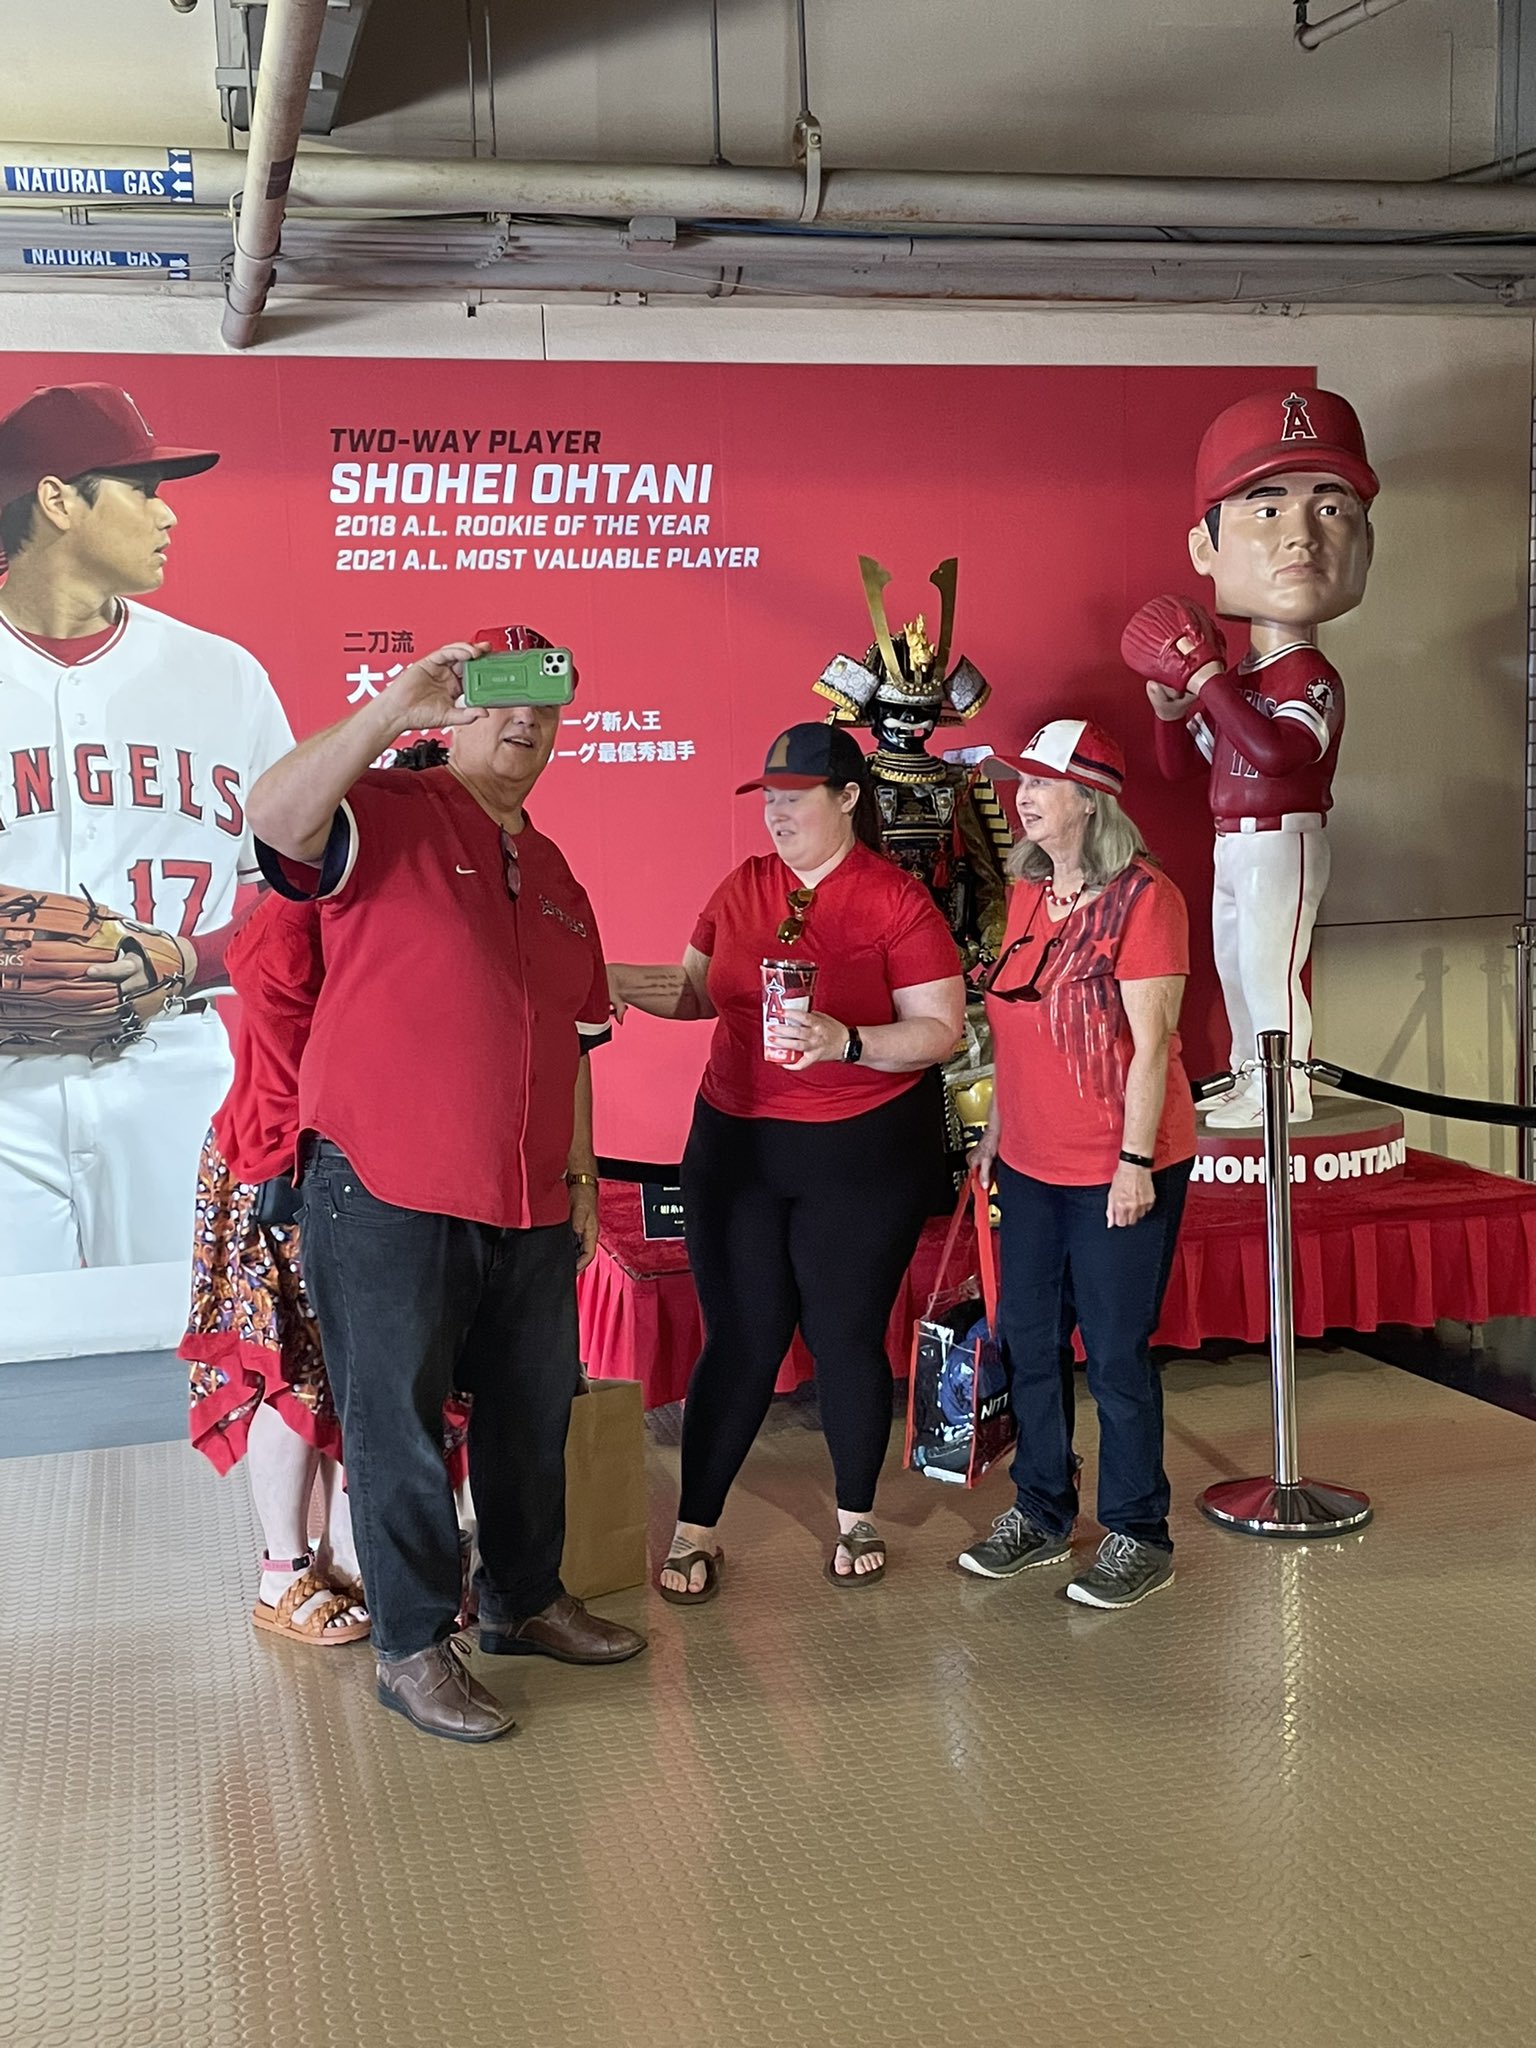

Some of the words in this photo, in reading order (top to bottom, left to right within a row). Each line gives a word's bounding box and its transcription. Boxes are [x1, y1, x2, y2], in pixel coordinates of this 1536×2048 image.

[14, 167, 112, 194] NATURAL
[123, 170, 165, 197] GAS
[31, 249, 116, 266] NATURAL
[126, 251, 162, 267] GAS
[330, 428, 481, 453] TWO-WAY
[489, 430, 602, 454] PLAYER
[329, 462, 518, 504] SHOHEI
[531, 463, 714, 504] OHTANI
[335, 515, 397, 536] 2018
[402, 515, 448, 536] A.L.
[455, 515, 548, 536] ROOKIE
[554, 515, 587, 536] OF
[593, 515, 640, 536] THE
[646, 514, 711, 535] YEAR
[336, 549, 397, 571] 2021
[402, 549, 448, 570] A.L.
[455, 549, 527, 570] MOST
[533, 548, 661, 570] VALUABLE
[666, 547, 760, 568] PLAYER
[343, 630, 415, 653] 二刀流
[549, 740, 696, 764] ーグ最優秀選手
[0, 743, 244, 837] NGELS
[127, 858, 212, 937] 17
[1189, 1154, 1306, 1184] HOHI
[1314, 1137, 1406, 1182] OHTANI
